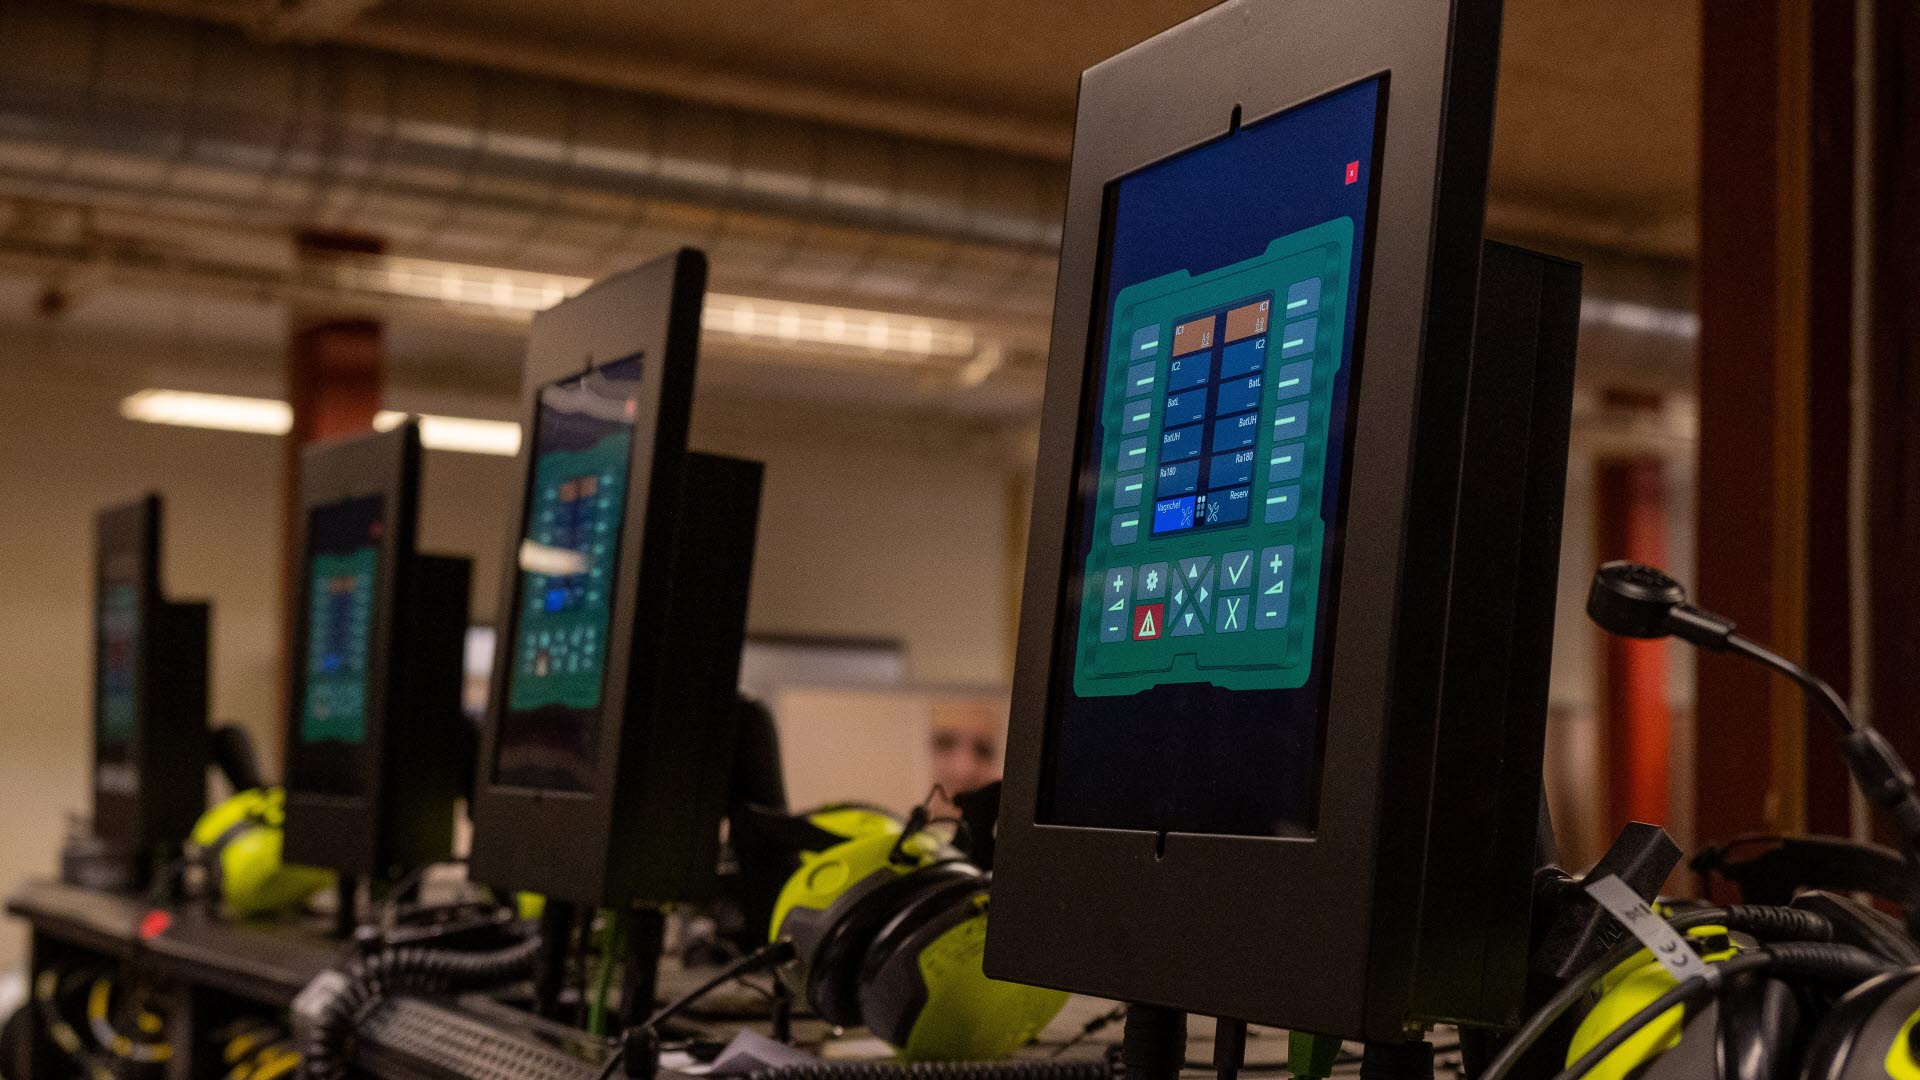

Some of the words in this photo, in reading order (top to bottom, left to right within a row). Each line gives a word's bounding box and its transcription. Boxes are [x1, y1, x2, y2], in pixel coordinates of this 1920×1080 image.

[1255, 339, 1265, 350] IC2
[1171, 361, 1181, 371] IC2
[1239, 415, 1257, 427] BatUH
[1163, 432, 1181, 443] BatUH
[1235, 451, 1254, 464] Ra180
[1159, 466, 1176, 478] Ra180
[1229, 490, 1249, 500] Reserv
